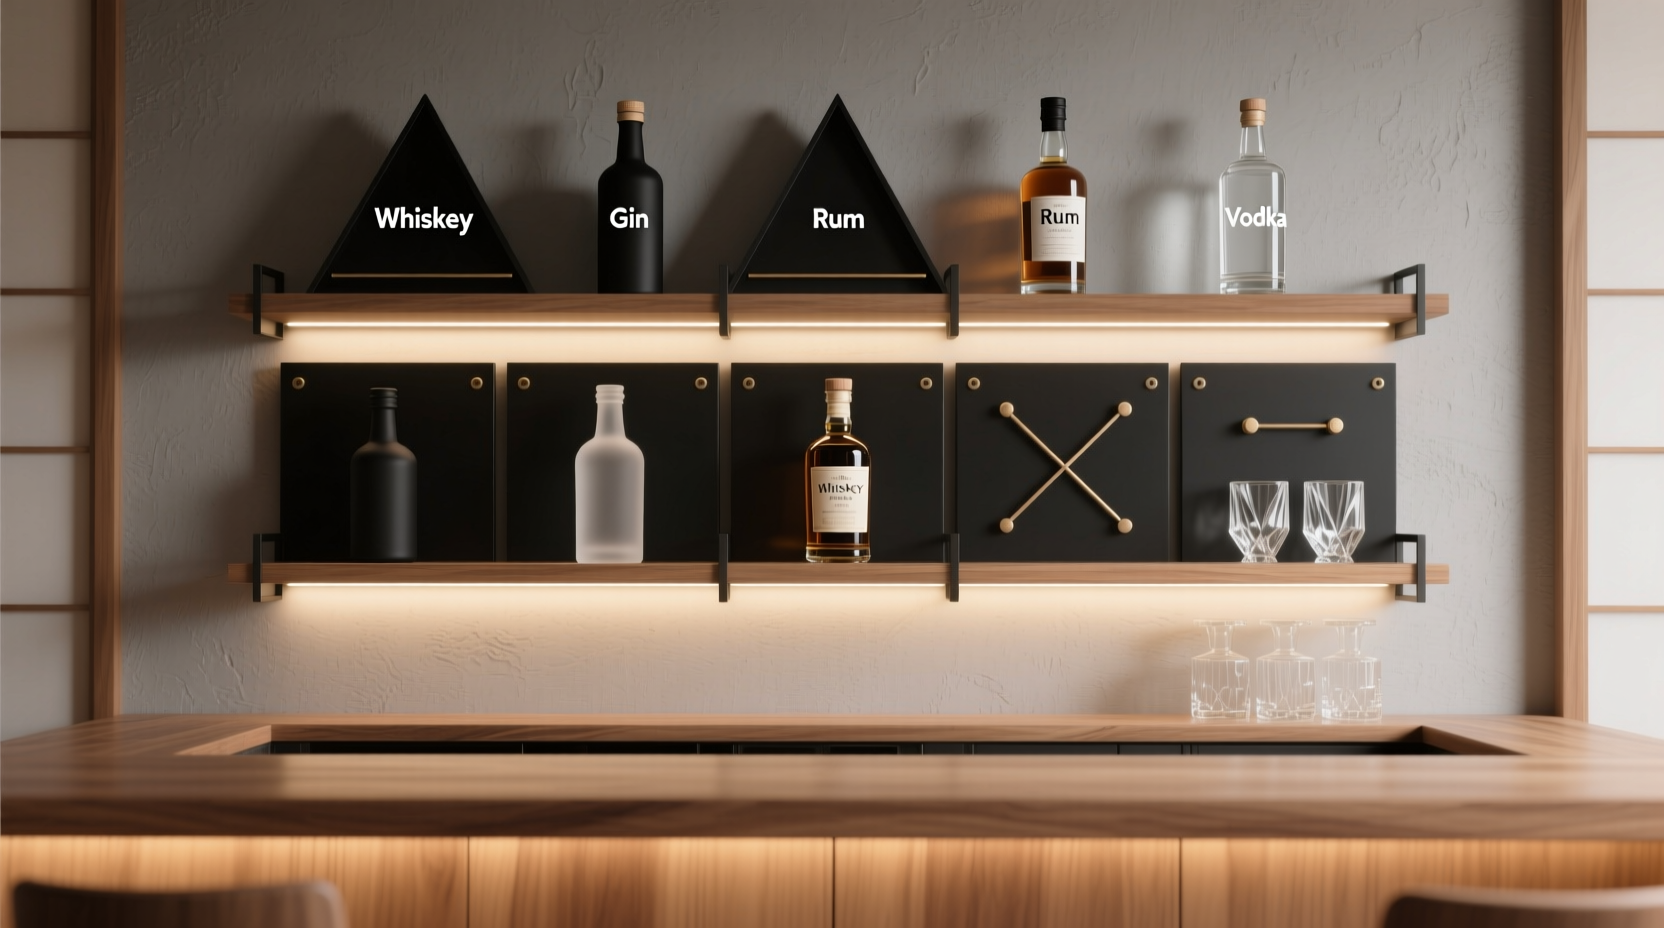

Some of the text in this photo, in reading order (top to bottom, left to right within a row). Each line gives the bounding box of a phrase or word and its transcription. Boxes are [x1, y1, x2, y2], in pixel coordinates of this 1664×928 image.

[374, 206, 474, 236] Whiskey
[609, 206, 649, 229] Gin
[813, 207, 865, 229] Rum
[1040, 208, 1079, 225] Rum
[1224, 205, 1287, 228] Vodka
